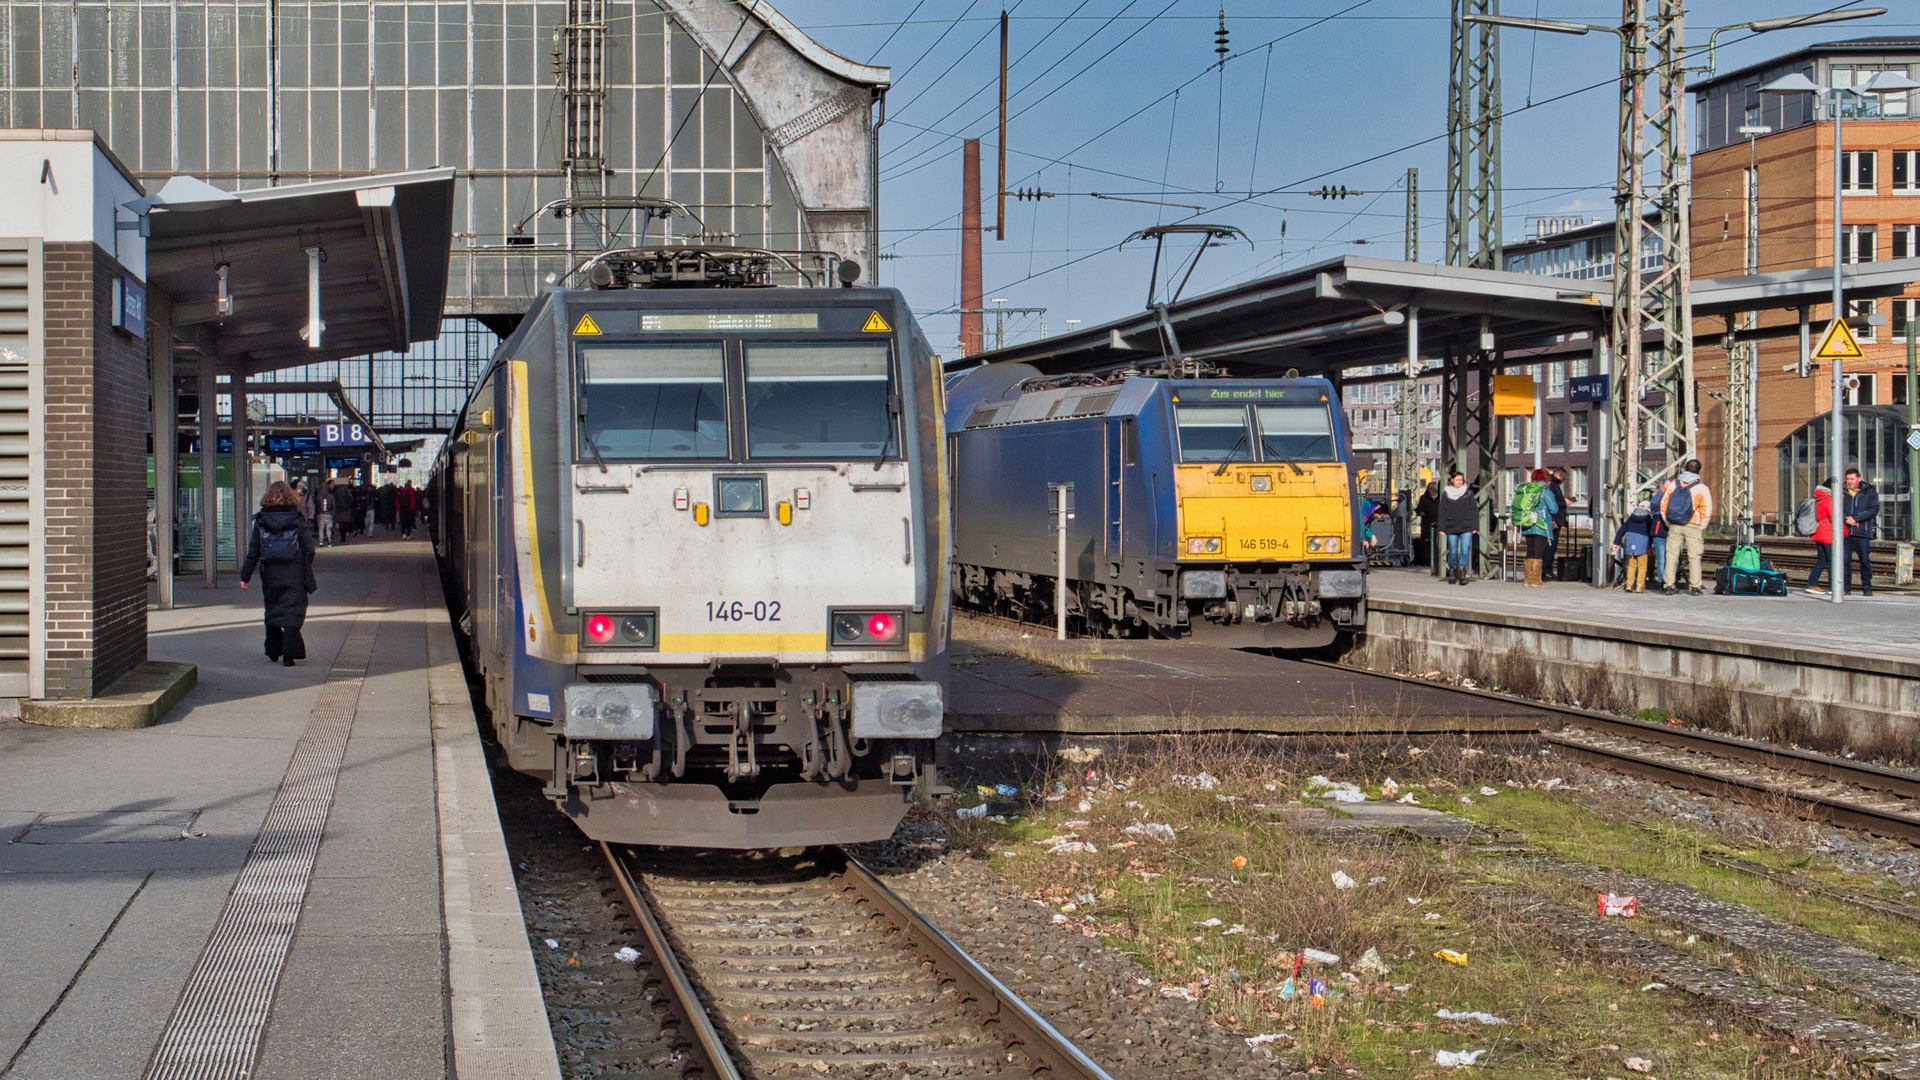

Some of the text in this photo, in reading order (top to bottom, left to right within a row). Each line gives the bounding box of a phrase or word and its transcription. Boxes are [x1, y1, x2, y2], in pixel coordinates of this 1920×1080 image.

[1210, 389, 1285, 398] Zug endet hier
[326, 424, 362, 442] B 8
[364, 452, 372, 463] C
[379, 452, 386, 463] 8
[1240, 539, 1289, 549] 146 519-4
[706, 600, 781, 622] 146-02
